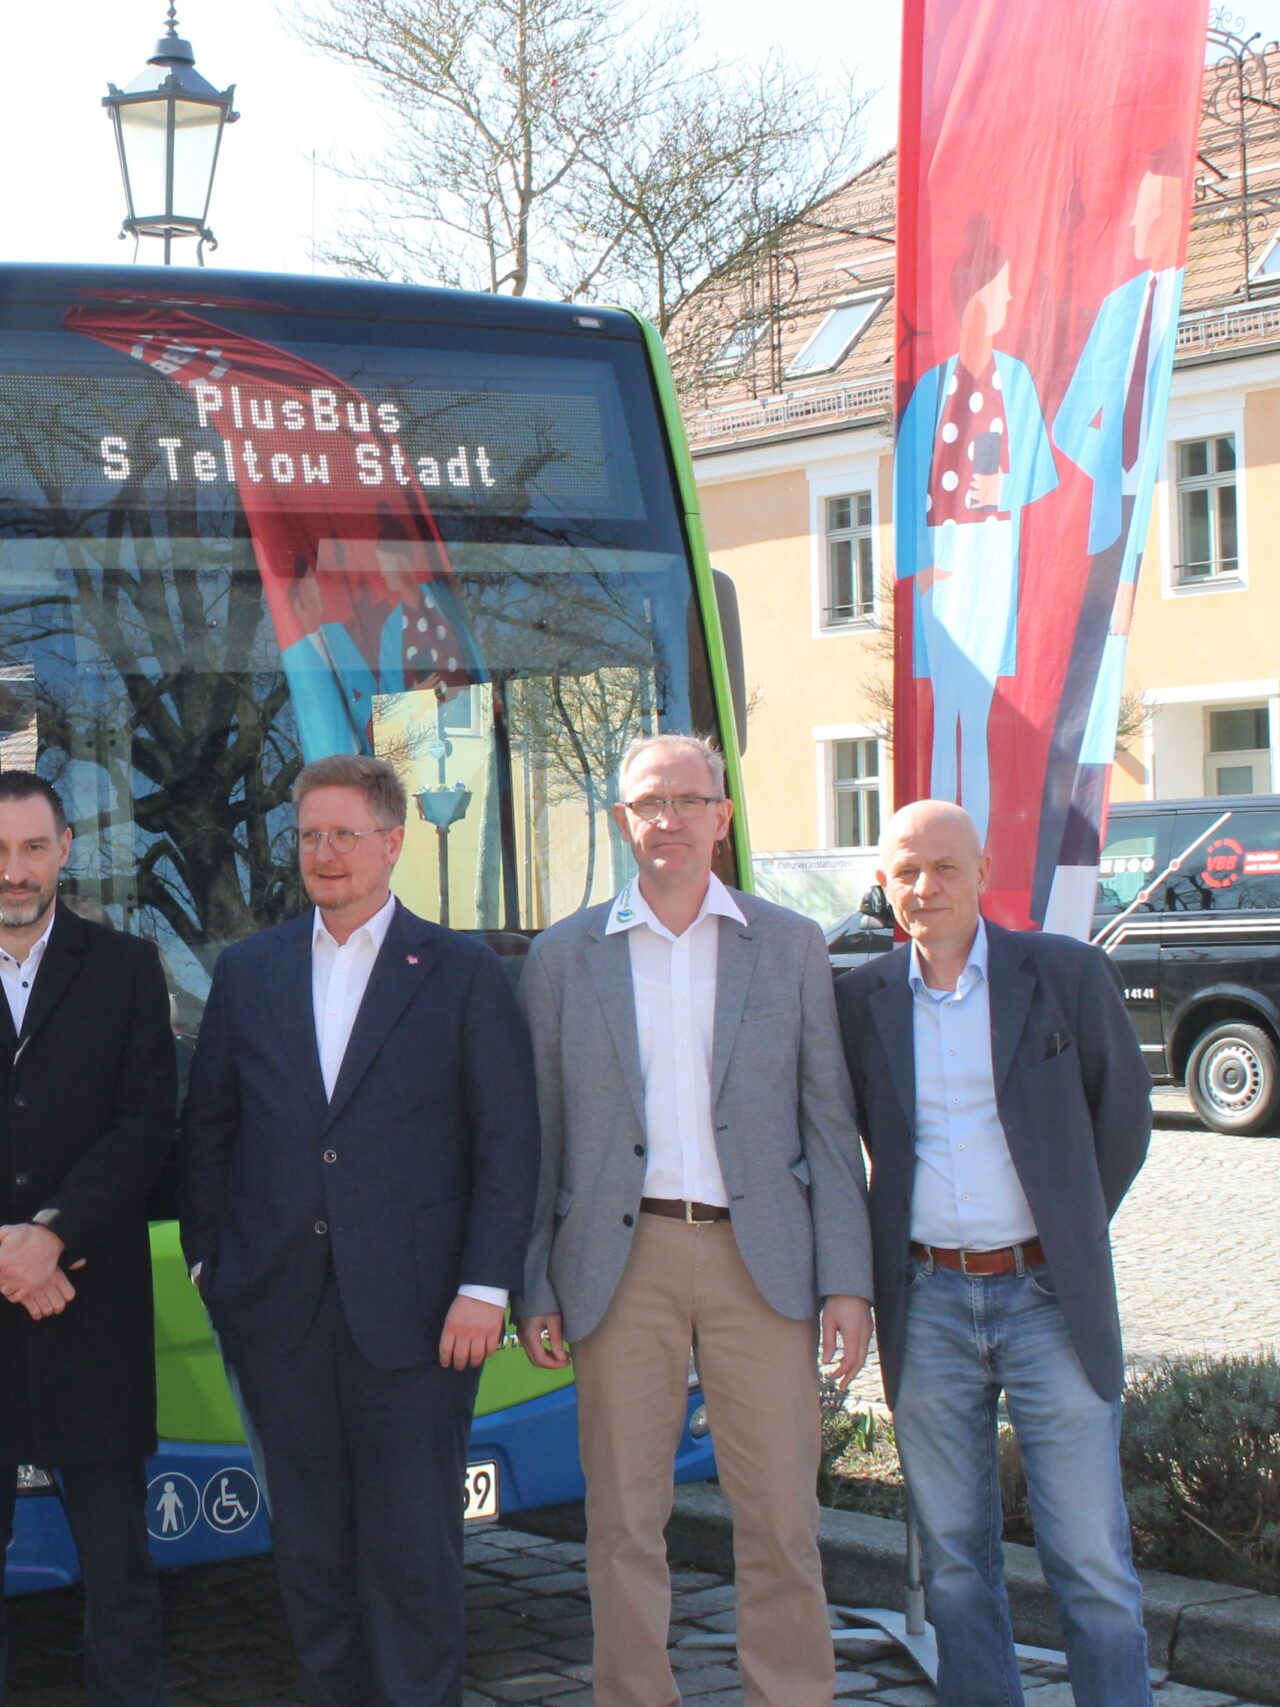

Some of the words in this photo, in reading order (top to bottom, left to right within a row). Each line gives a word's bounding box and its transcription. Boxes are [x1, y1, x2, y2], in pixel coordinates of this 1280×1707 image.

[194, 383, 401, 434] PlusBus
[100, 435, 131, 481] S
[158, 436, 330, 485] Teltow
[357, 443, 497, 489] Stadt
[1207, 855, 1239, 872] VBB
